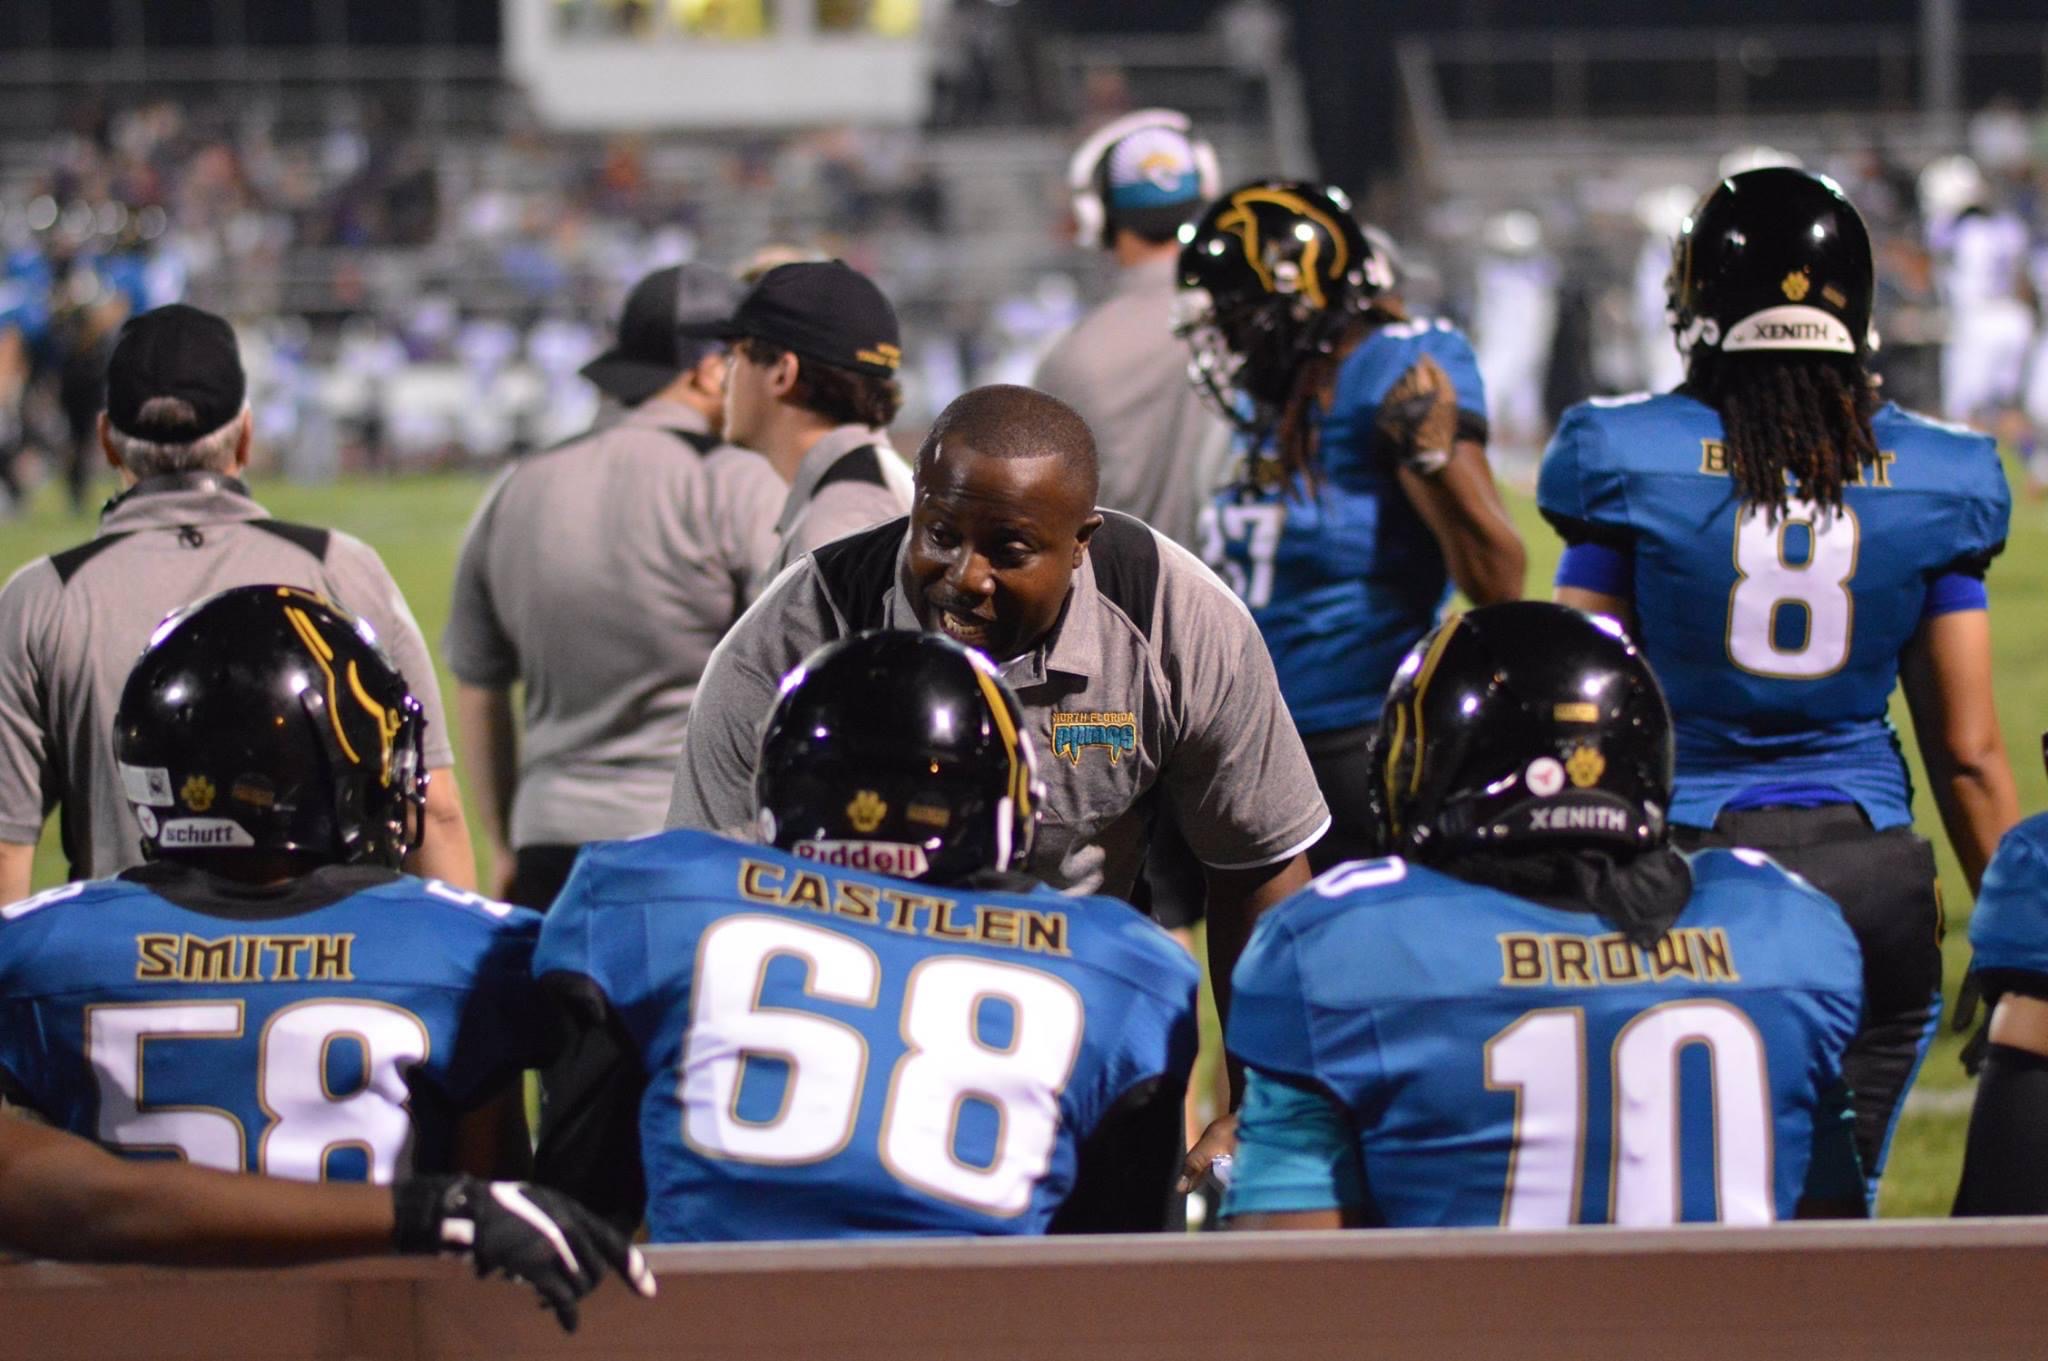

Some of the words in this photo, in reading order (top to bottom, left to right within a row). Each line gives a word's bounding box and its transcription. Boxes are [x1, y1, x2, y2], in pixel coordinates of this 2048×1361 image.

[1754, 323, 1828, 341] XENITH
[1727, 496, 1860, 679] 8
[1053, 711, 1087, 722] NORTH
[1090, 711, 1135, 722] FLORIDA
[166, 823, 235, 843] schutt
[1529, 805, 1627, 832] XENITH
[799, 844, 916, 873] Riddell
[738, 857, 1073, 957] CASTLEN
[135, 933, 355, 982] SMITH
[1496, 927, 1740, 984] BROWN
[84, 997, 431, 1185] 58
[679, 912, 1086, 1219] 68
[1484, 998, 1775, 1229] 10
